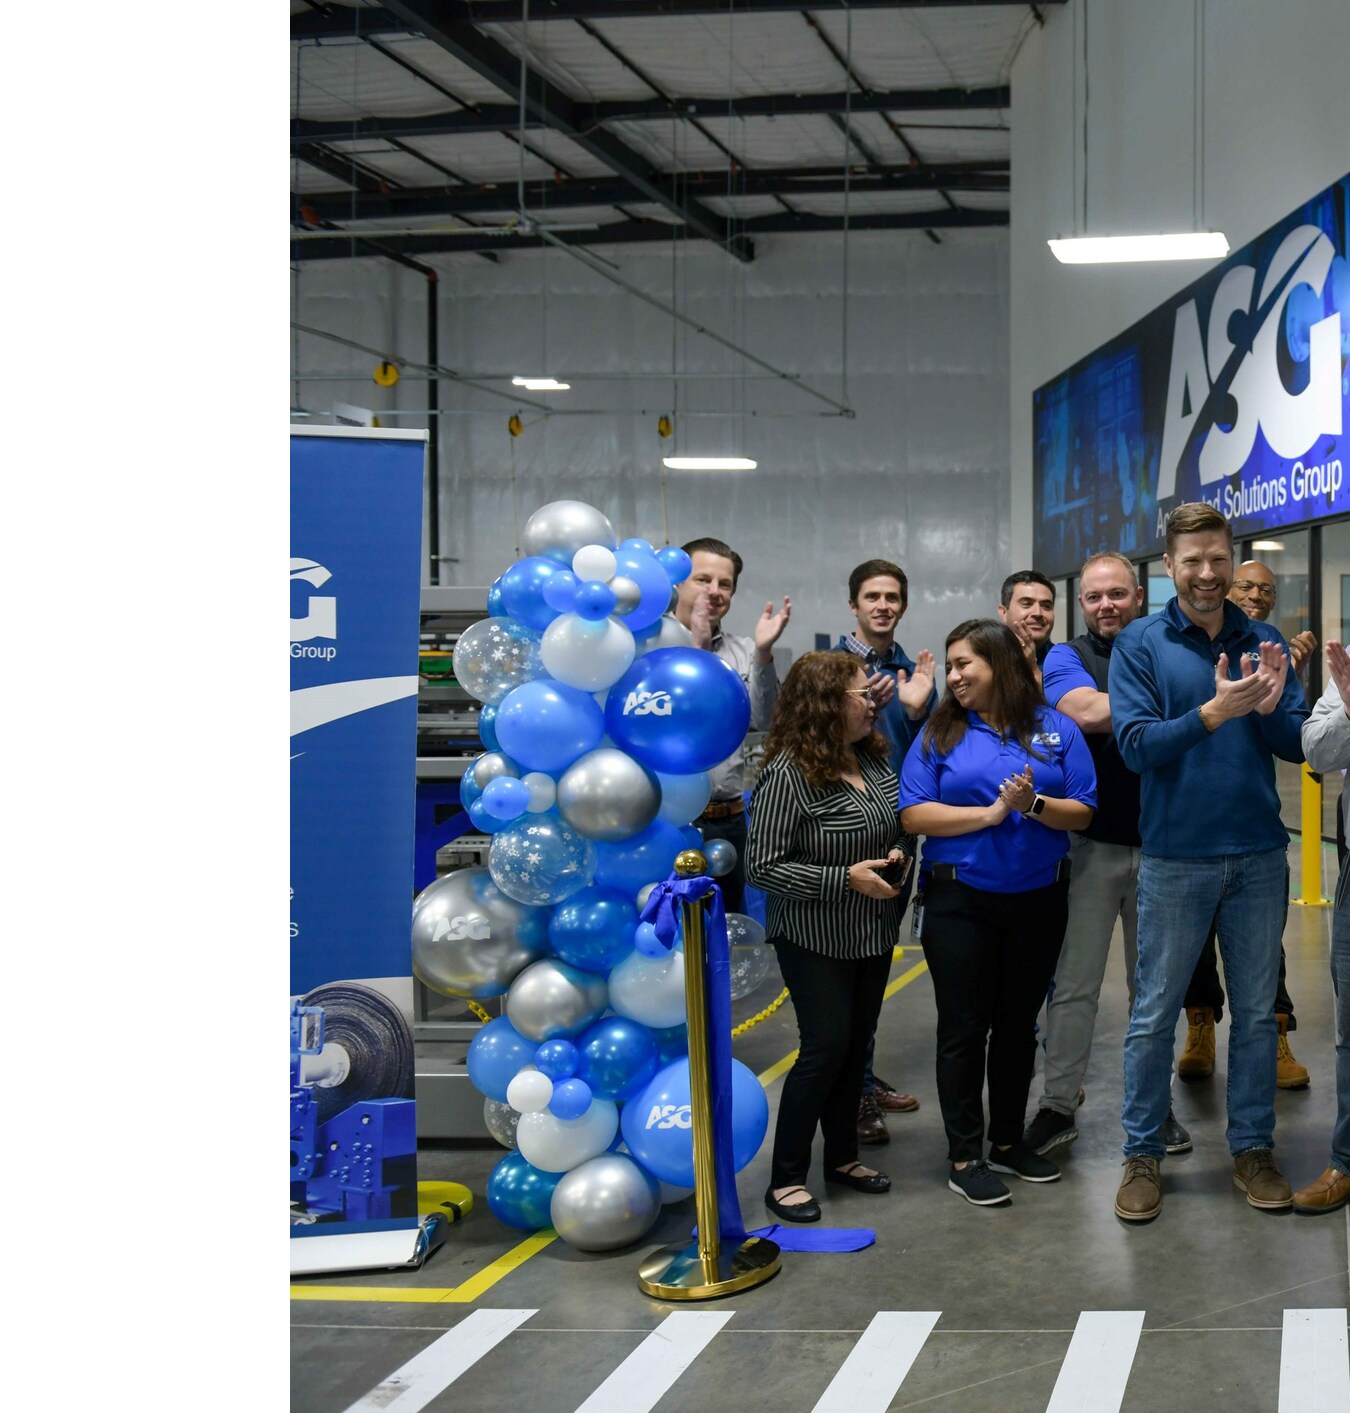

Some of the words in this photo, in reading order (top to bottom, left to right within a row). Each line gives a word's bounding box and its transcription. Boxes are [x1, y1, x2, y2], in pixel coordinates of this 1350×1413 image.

[1157, 224, 1342, 500] ASG
[1223, 475, 1287, 521] Solutions
[1291, 459, 1342, 502] Group
[290, 643, 336, 662] Group
[622, 690, 672, 717] ASG
[431, 914, 491, 943] ASG
